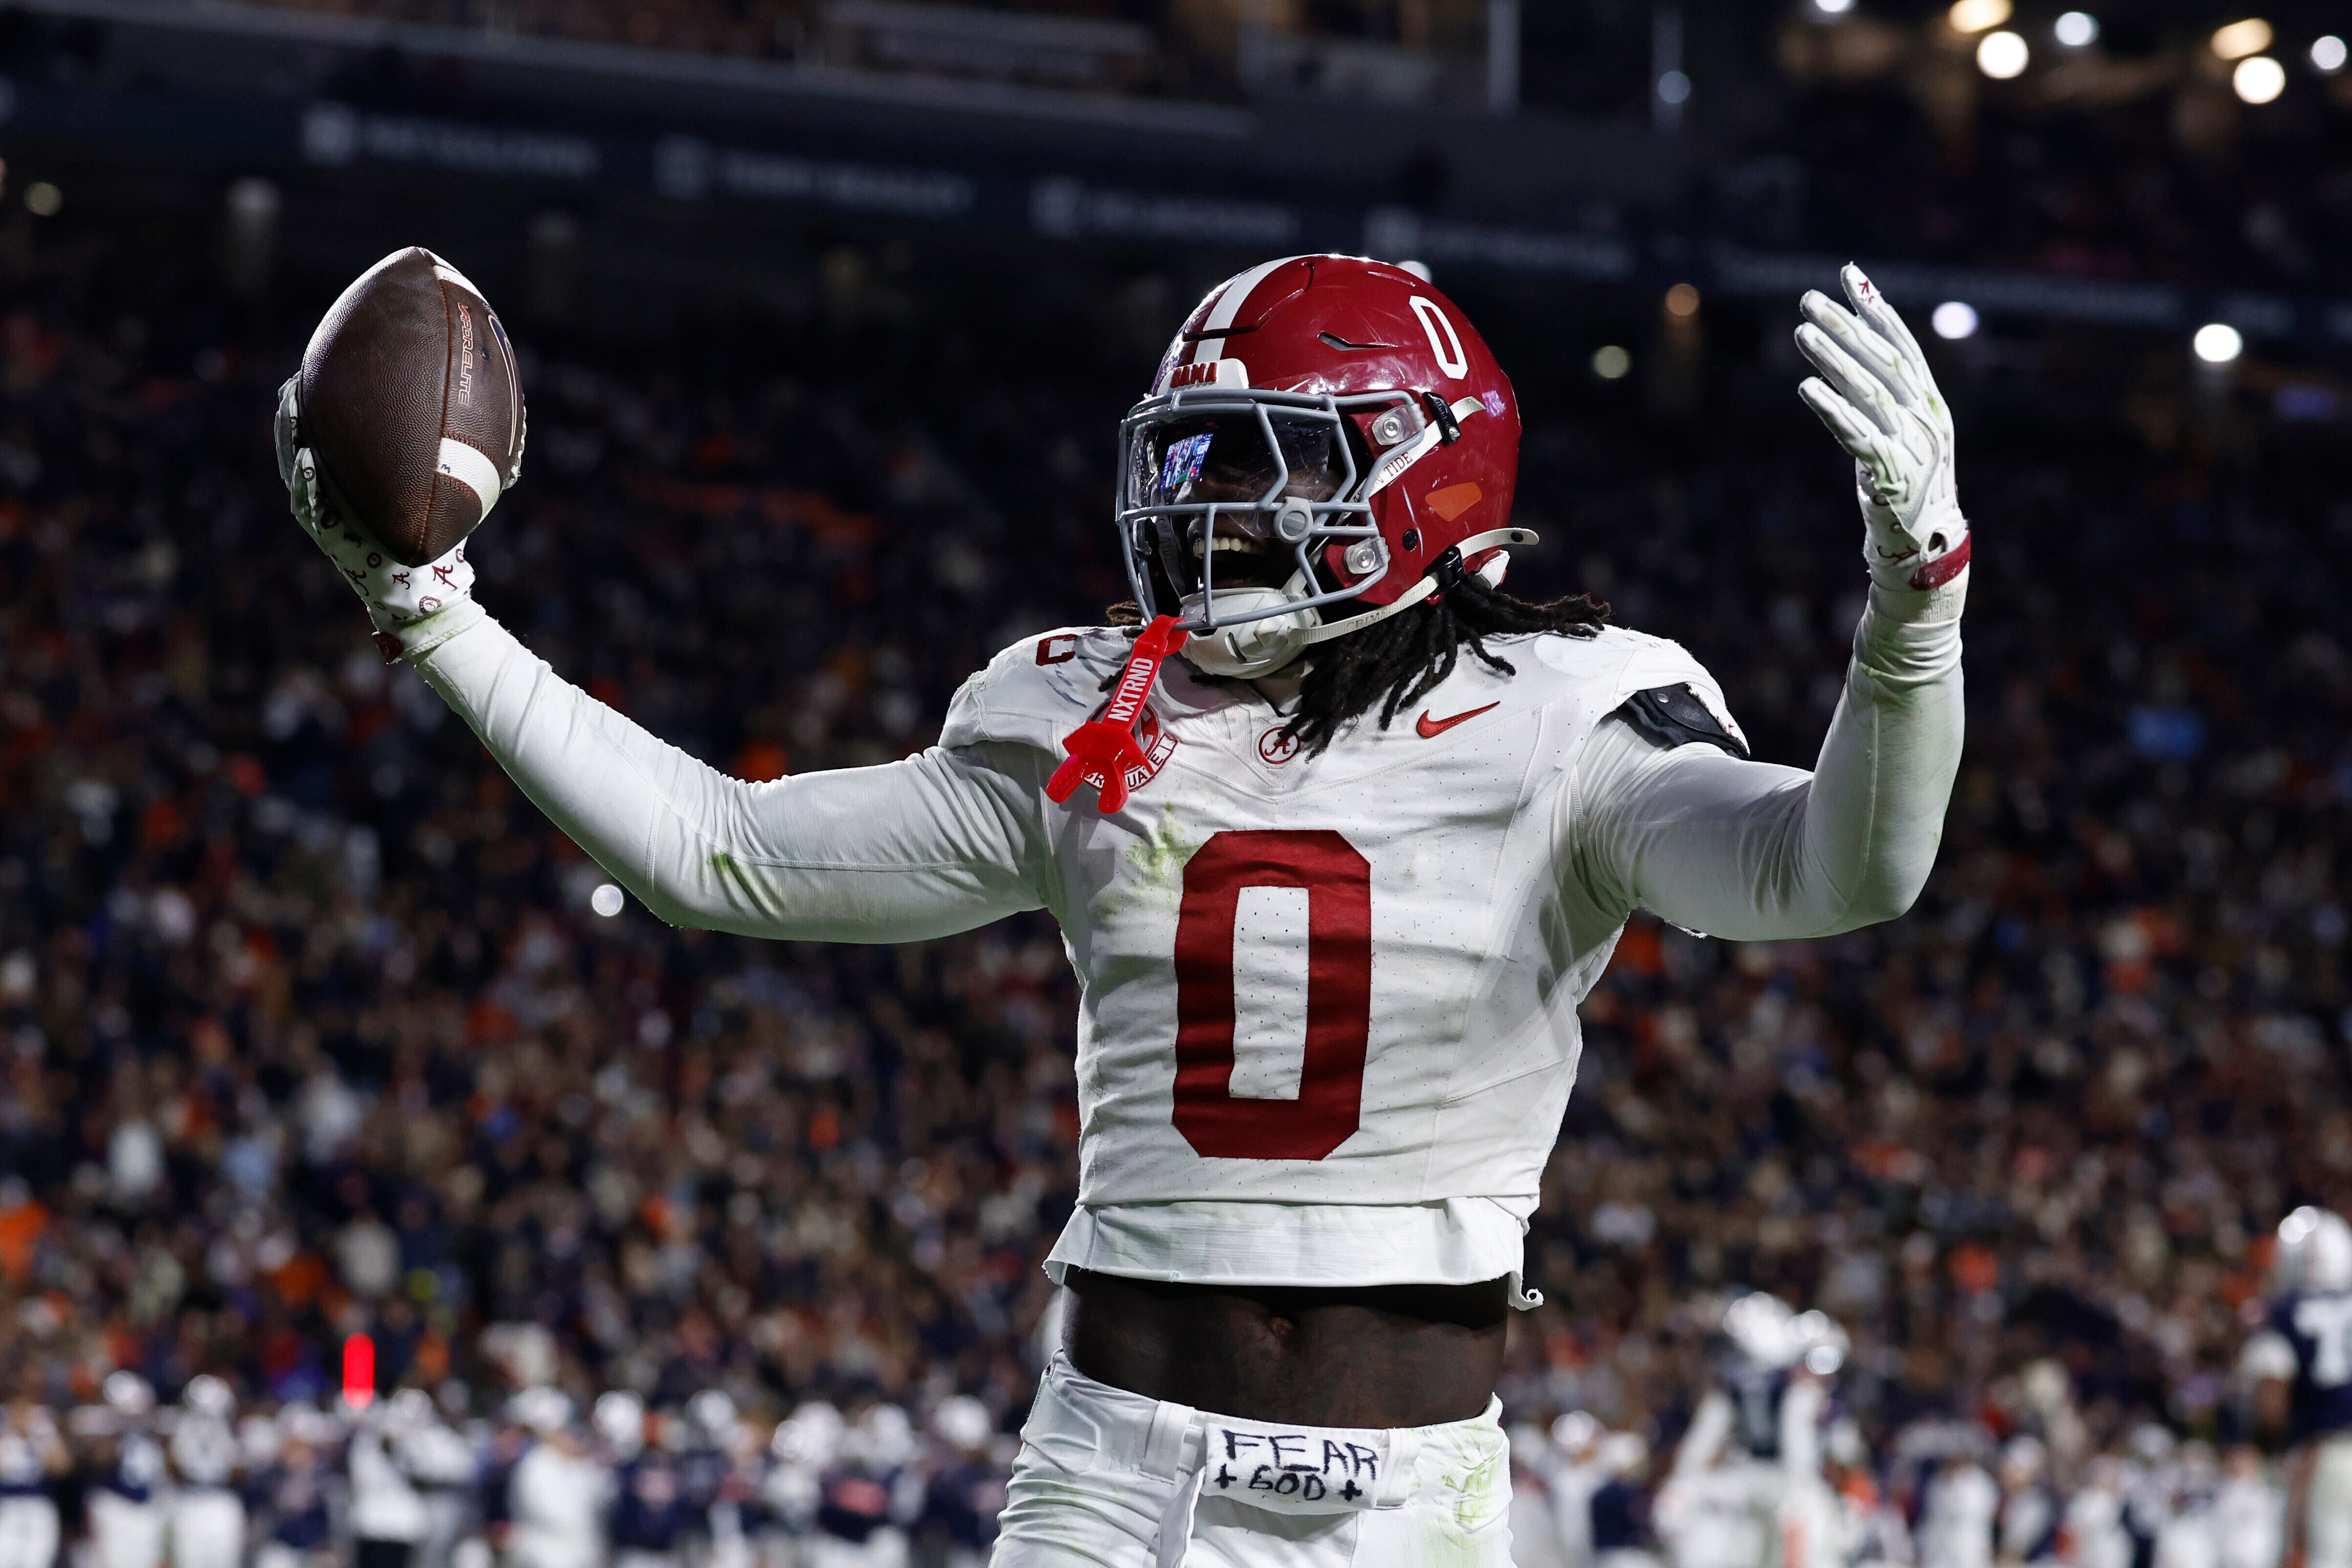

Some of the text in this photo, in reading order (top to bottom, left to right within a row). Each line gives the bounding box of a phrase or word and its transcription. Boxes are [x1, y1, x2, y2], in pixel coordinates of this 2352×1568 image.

[458, 302, 473, 405] VAPOR ELITE
[1408, 295, 1469, 380] 0
[1170, 362, 1217, 388] BAMA
[1383, 451, 1413, 477] TIDE
[392, 572, 410, 590] A
[432, 564, 458, 592] A
[1107, 657, 1154, 722] NXTRND
[1171, 829, 1371, 1161] 0
[1222, 1429, 1378, 1480] FEAR
[1248, 1464, 1326, 1501] GOD
